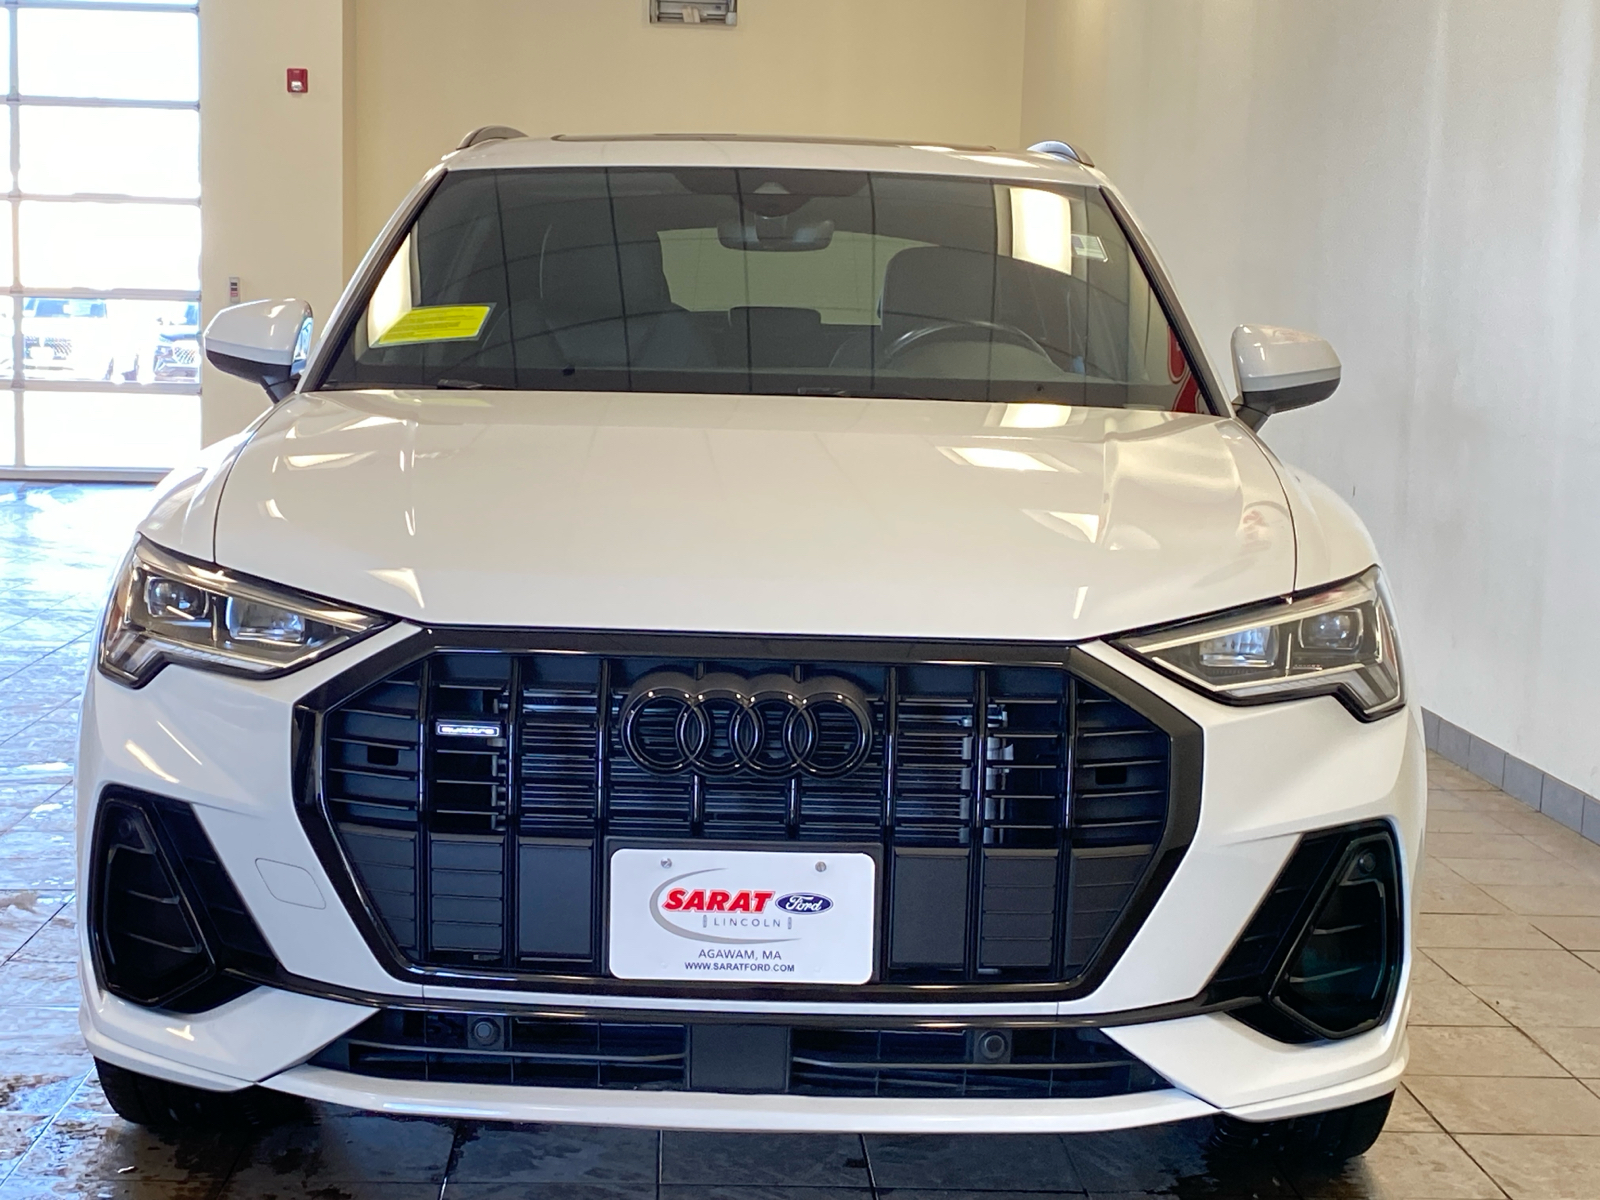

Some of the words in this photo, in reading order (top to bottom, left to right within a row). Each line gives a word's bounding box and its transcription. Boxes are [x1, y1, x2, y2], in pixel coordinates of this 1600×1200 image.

[663, 888, 775, 913] SARAT
[785, 894, 823, 912] Ford
[713, 917, 781, 928] LINCOLN
[698, 949, 758, 961] AGAWAM,
[762, 950, 782, 960] MA
[684, 962, 795, 972] WWW.SARATFORD.COM
